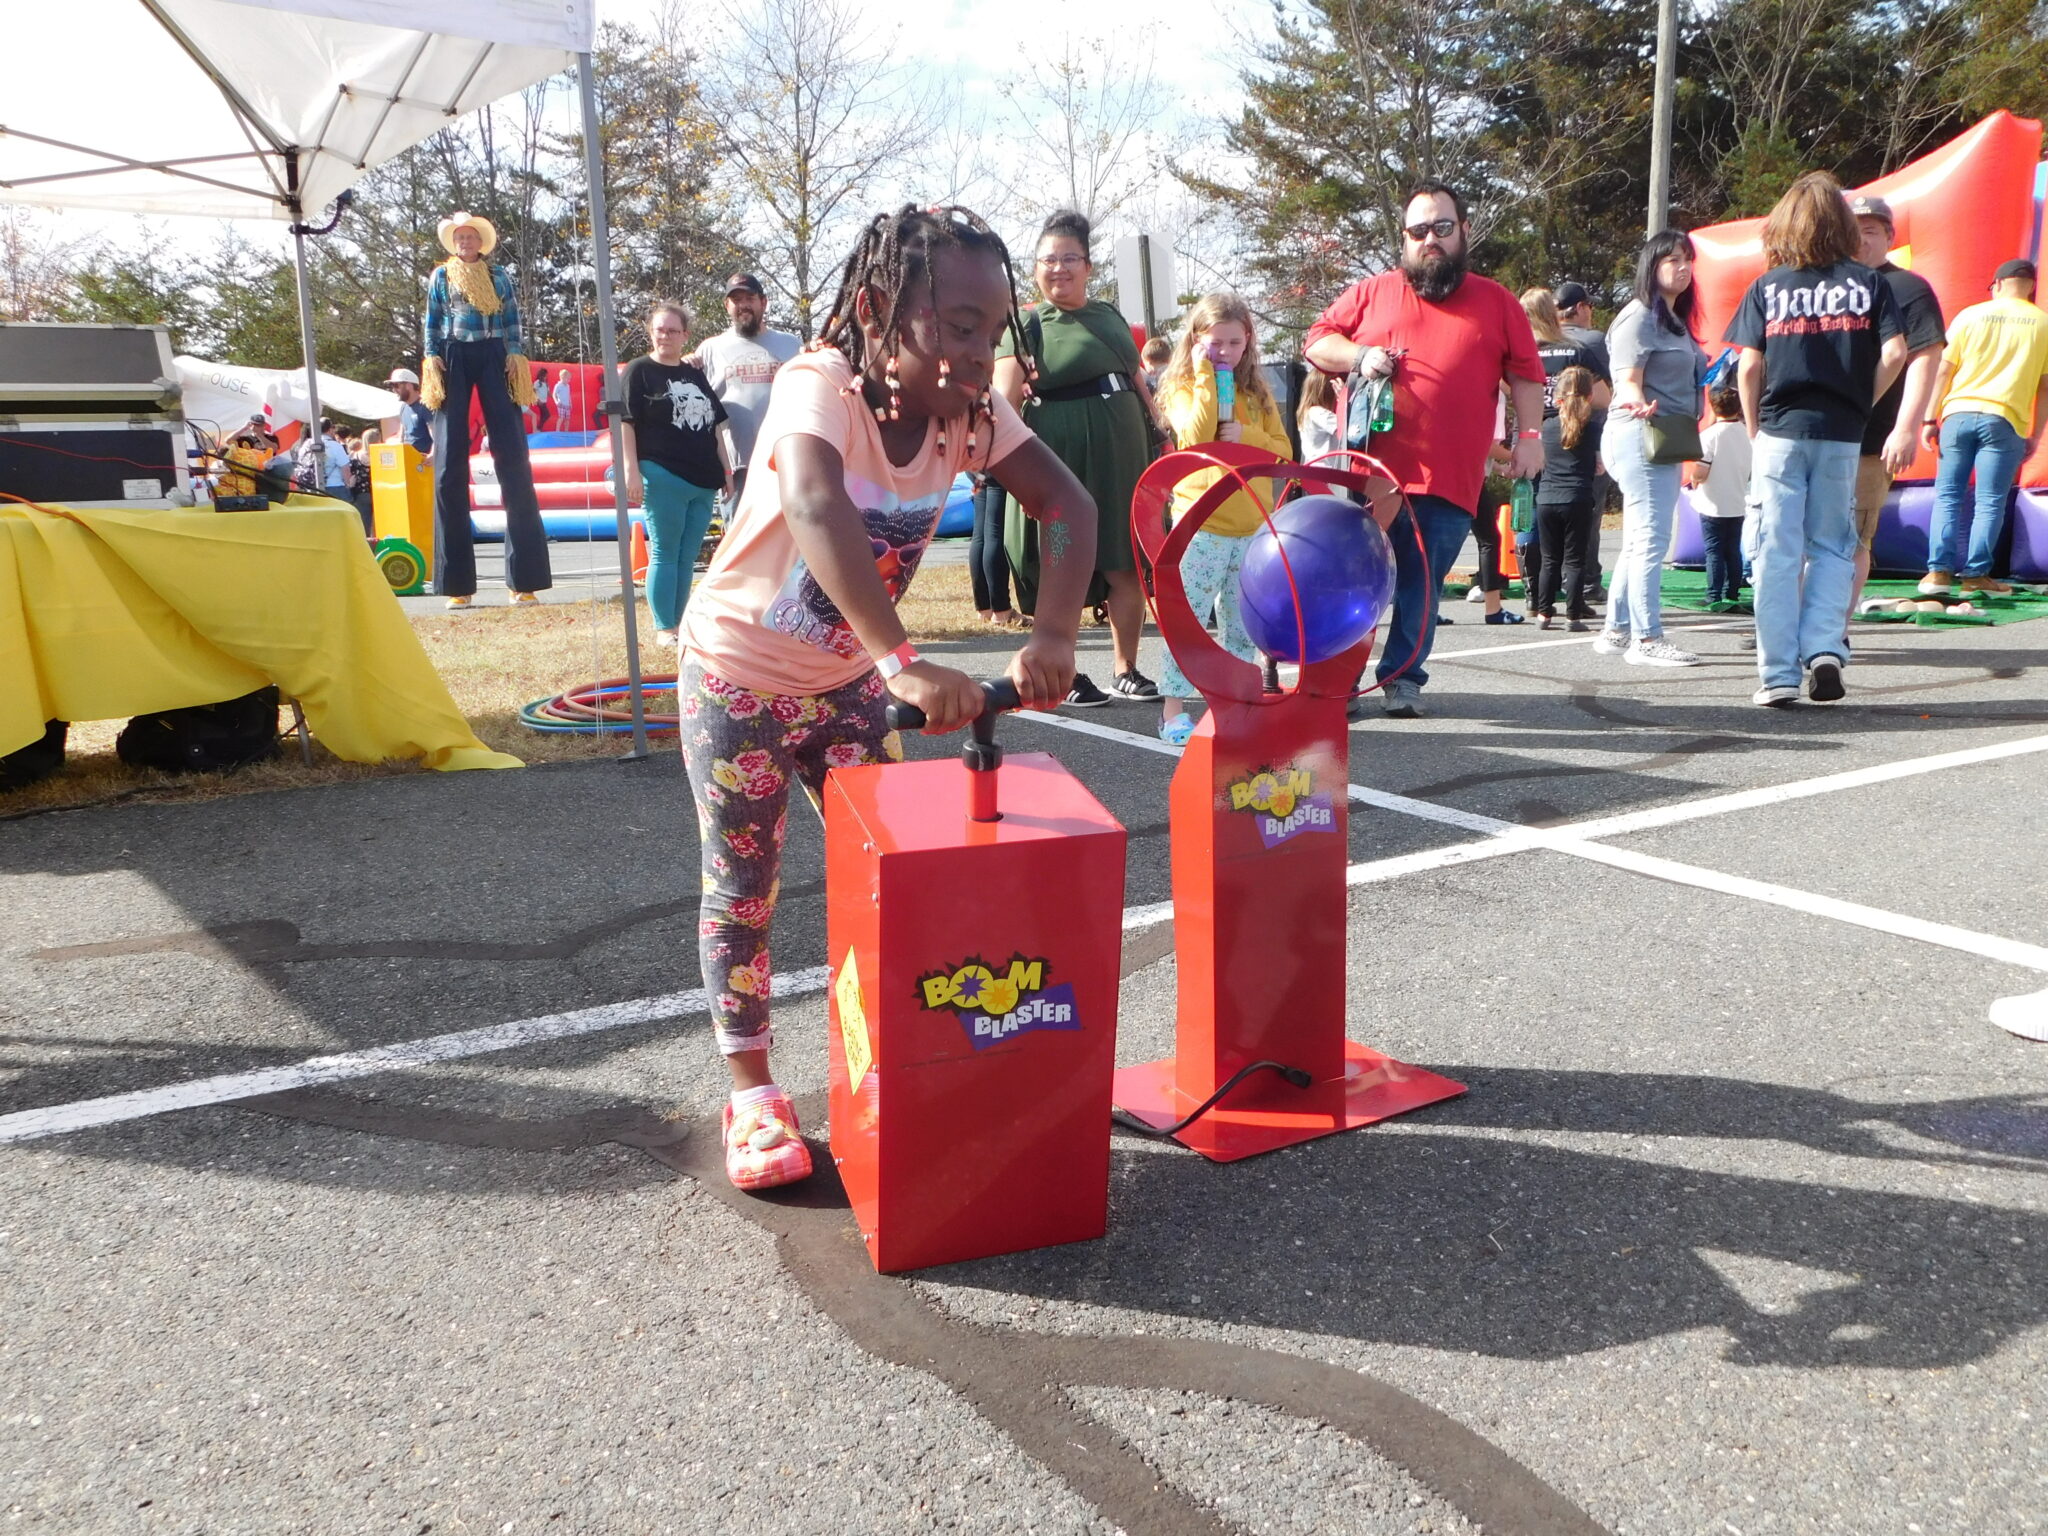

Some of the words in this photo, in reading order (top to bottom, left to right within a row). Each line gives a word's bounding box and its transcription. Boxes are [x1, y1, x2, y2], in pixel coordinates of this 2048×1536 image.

[725, 362, 784, 379] CHIEF
[1231, 770, 1310, 817] BOOM
[1266, 804, 1331, 838] BLASTER
[923, 961, 1042, 1015] BOOM
[974, 999, 1072, 1039] BLASTER
